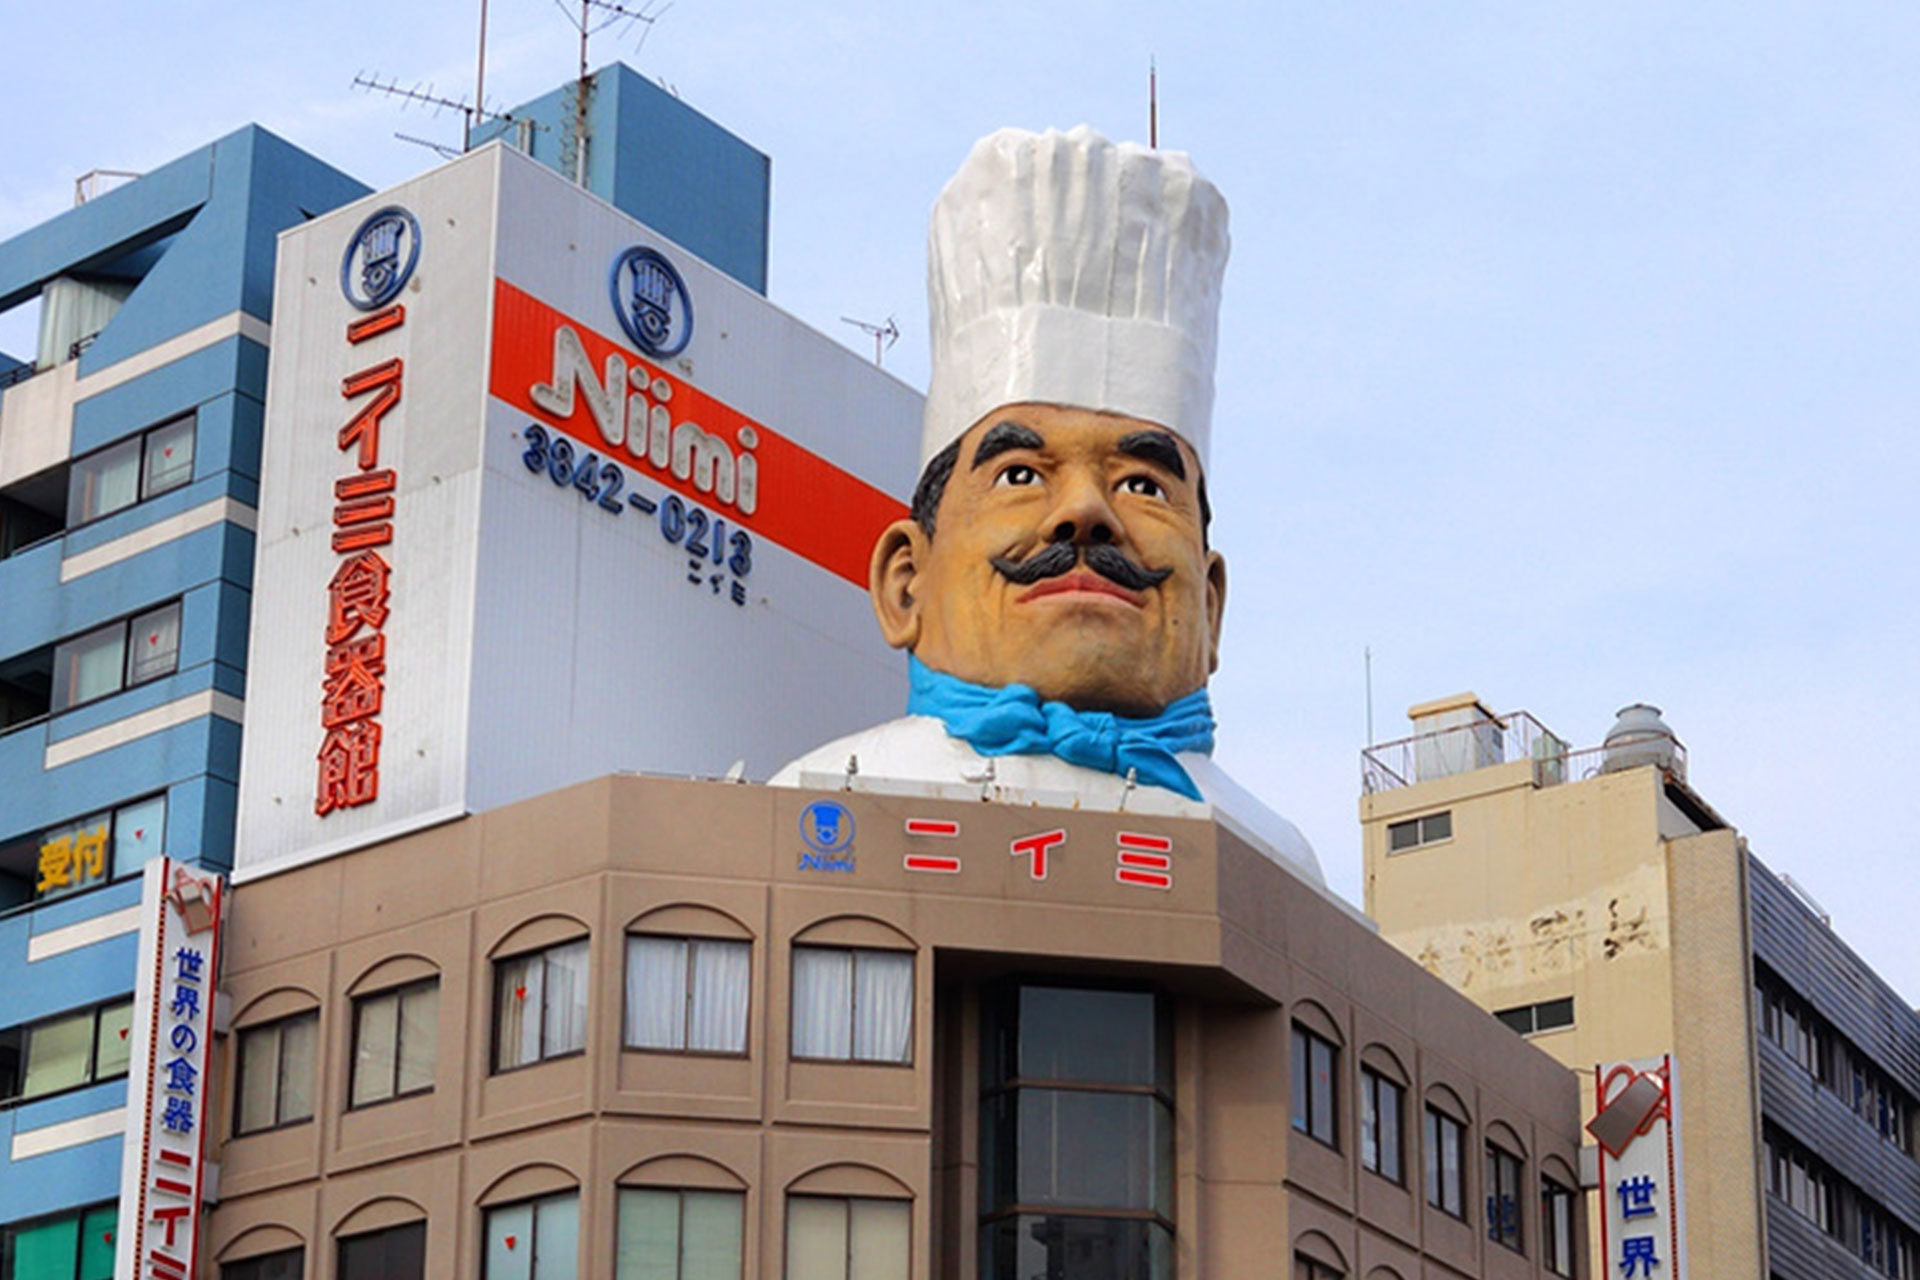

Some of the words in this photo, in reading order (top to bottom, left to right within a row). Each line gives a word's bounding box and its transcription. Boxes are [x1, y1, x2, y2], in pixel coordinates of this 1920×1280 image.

[530, 325, 758, 515] Niimi
[315, 303, 405, 818] ニイミ食器館
[522, 424, 751, 576] 3842-0213
[37, 825, 106, 891] 受付
[905, 818, 1171, 888] ニイミ
[165, 947, 203, 1134] 世界の食器
[1616, 1175, 1659, 1279] 世界
